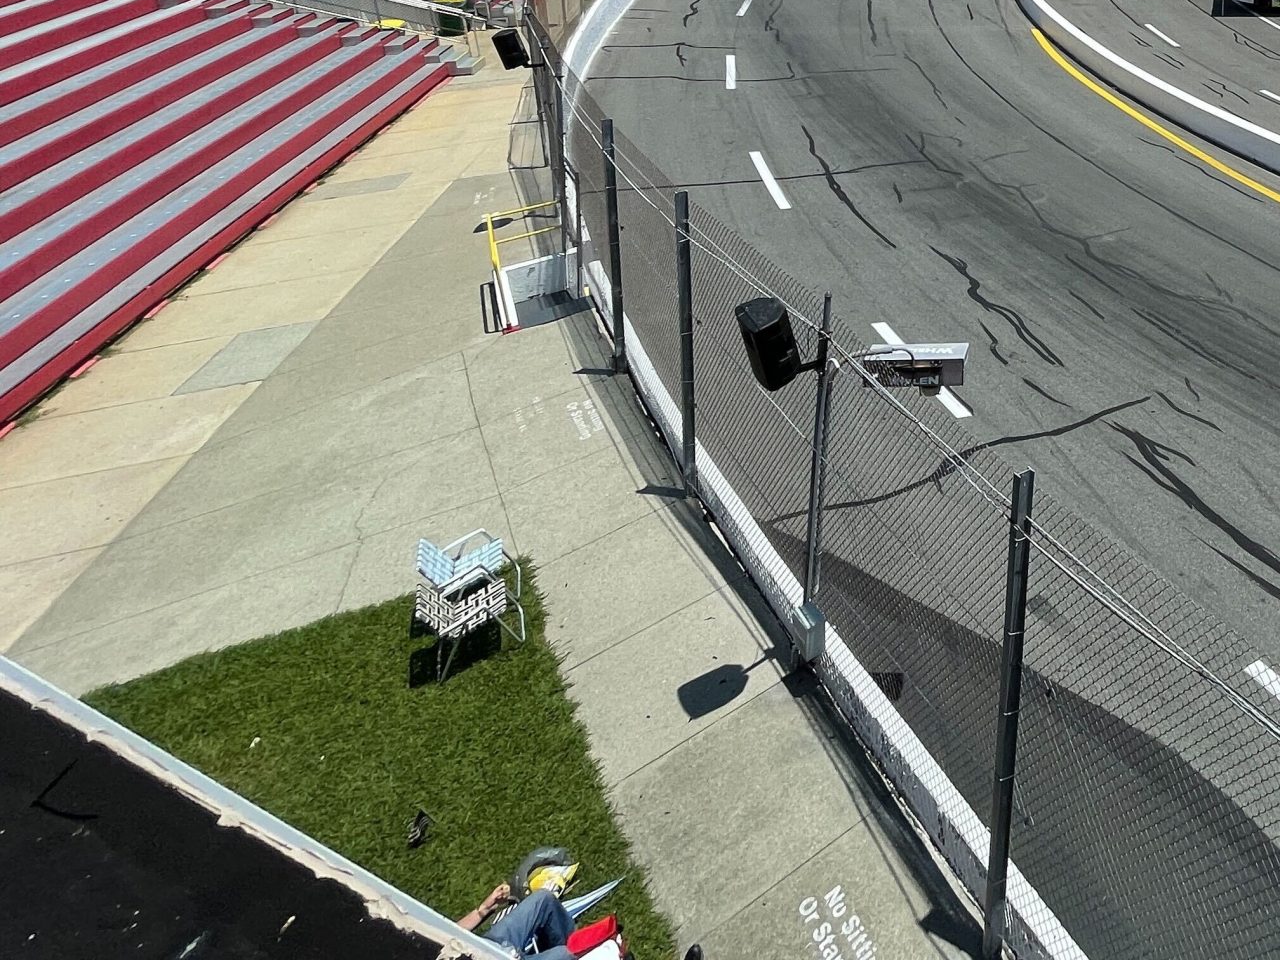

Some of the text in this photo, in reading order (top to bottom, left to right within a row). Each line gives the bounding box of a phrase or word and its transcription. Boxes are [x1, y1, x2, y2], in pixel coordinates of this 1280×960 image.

[798, 896, 820, 924] Or
[823, 884, 877, 960] No Sitti
